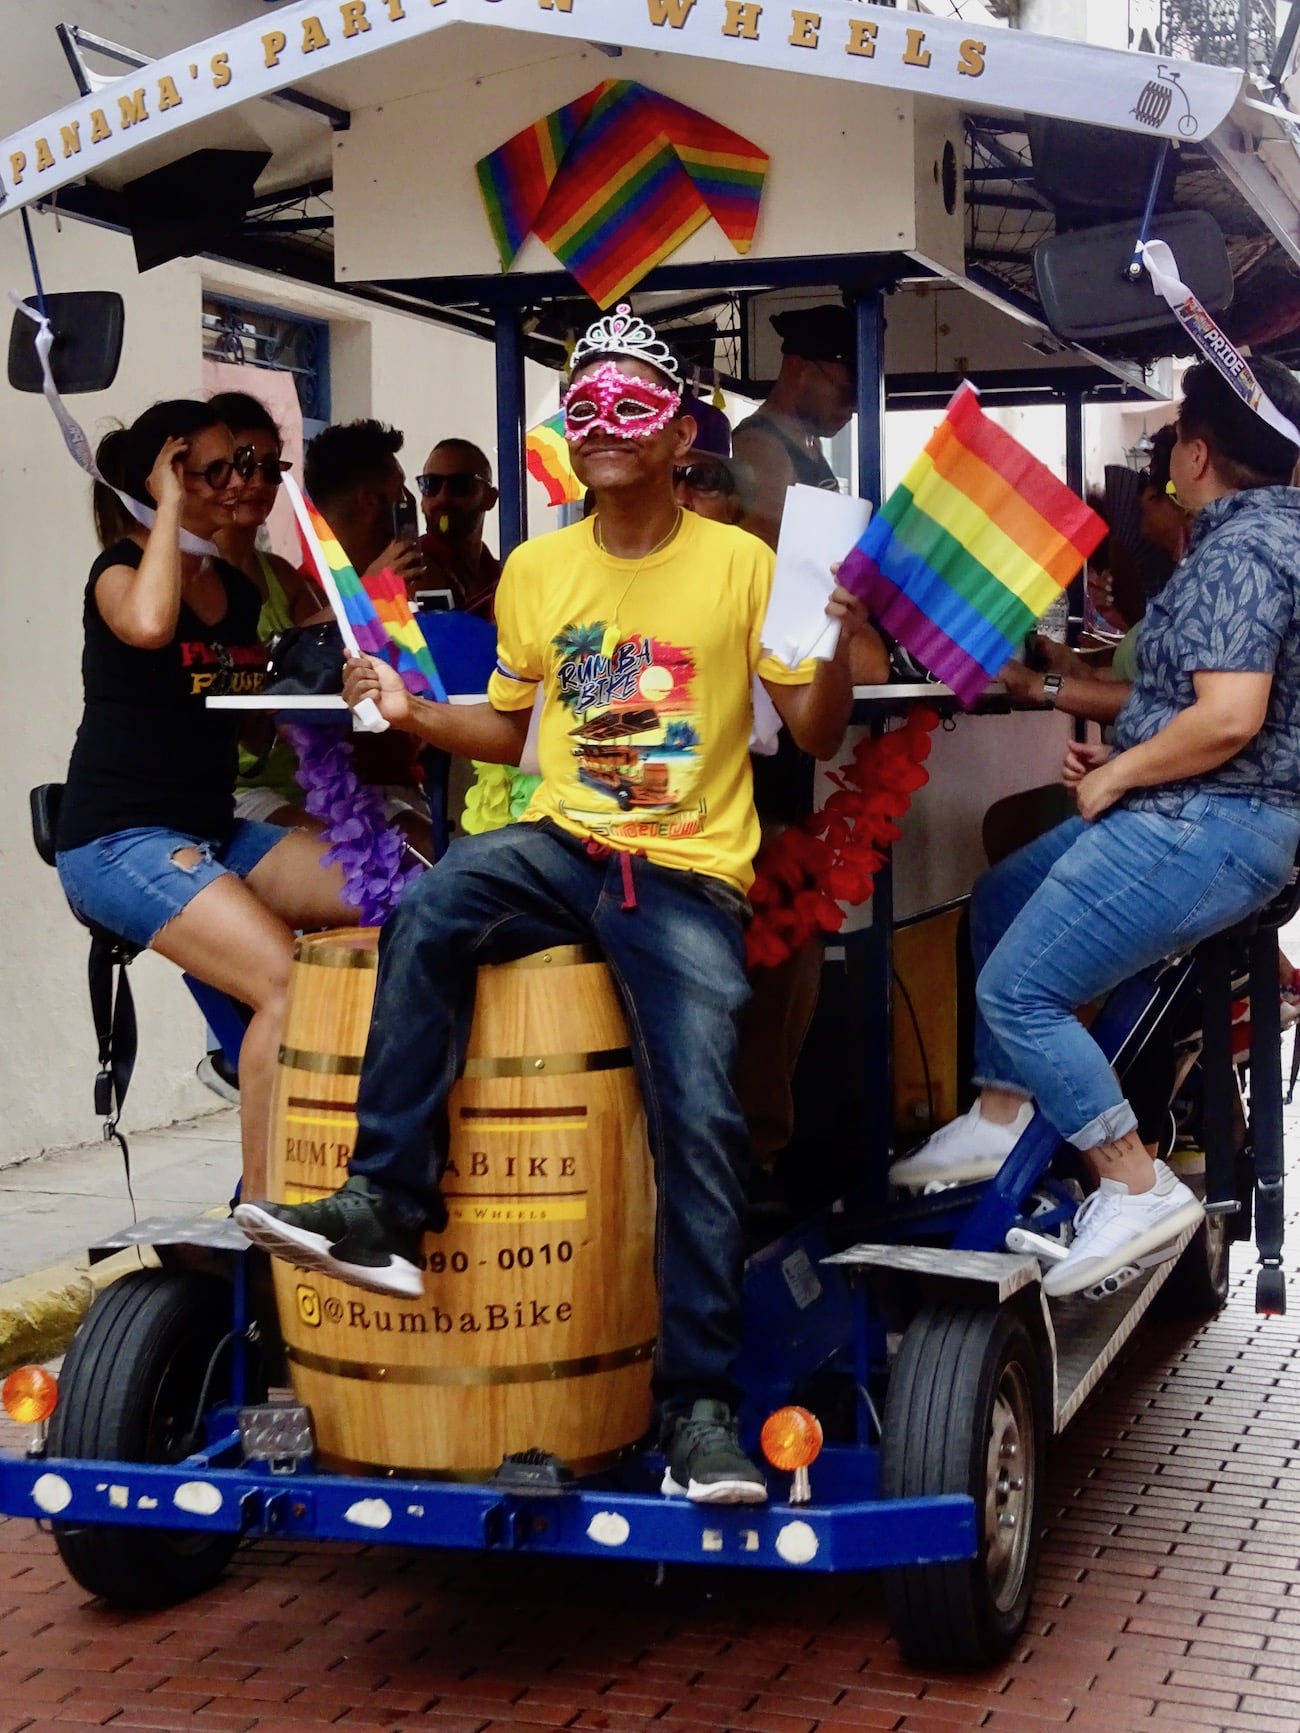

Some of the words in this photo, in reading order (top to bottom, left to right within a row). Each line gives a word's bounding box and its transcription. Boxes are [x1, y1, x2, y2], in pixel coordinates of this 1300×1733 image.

[9, 51, 232, 185] PANAMA'S
[261, 0, 448, 68] PART
[645, 0, 987, 78] WHEELS
[1204, 330, 1244, 376] PRIDE
[558, 639, 652, 692] RUMBA
[576, 671, 642, 714] BIKE
[474, 1207, 547, 1220] WHEELS
[325, 1299, 573, 1333] @RumbaBike
